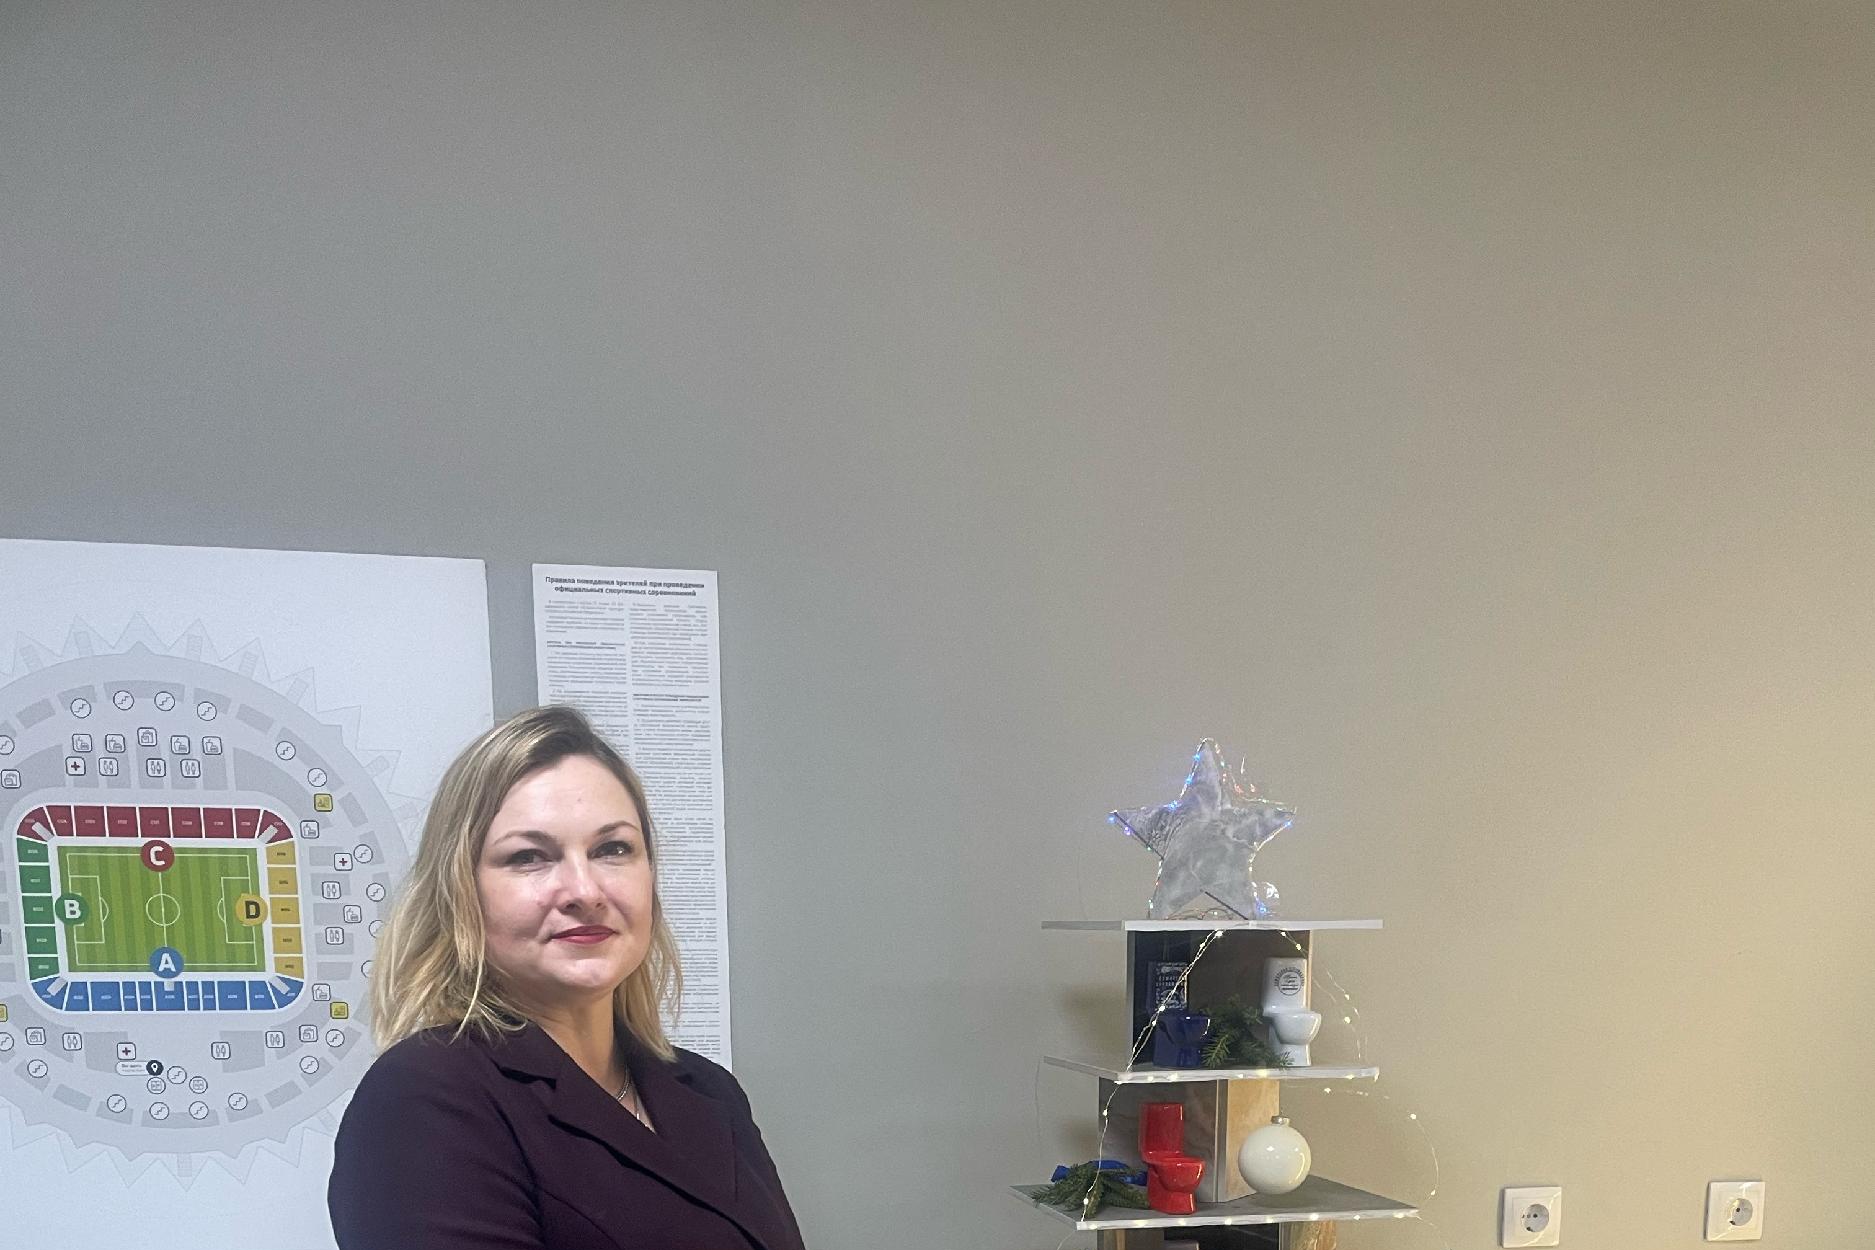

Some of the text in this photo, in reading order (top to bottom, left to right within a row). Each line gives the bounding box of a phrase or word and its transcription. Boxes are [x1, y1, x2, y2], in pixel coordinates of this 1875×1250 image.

[63, 899, 82, 919] B
[244, 900, 261, 919] D
[158, 952, 176, 972] A
